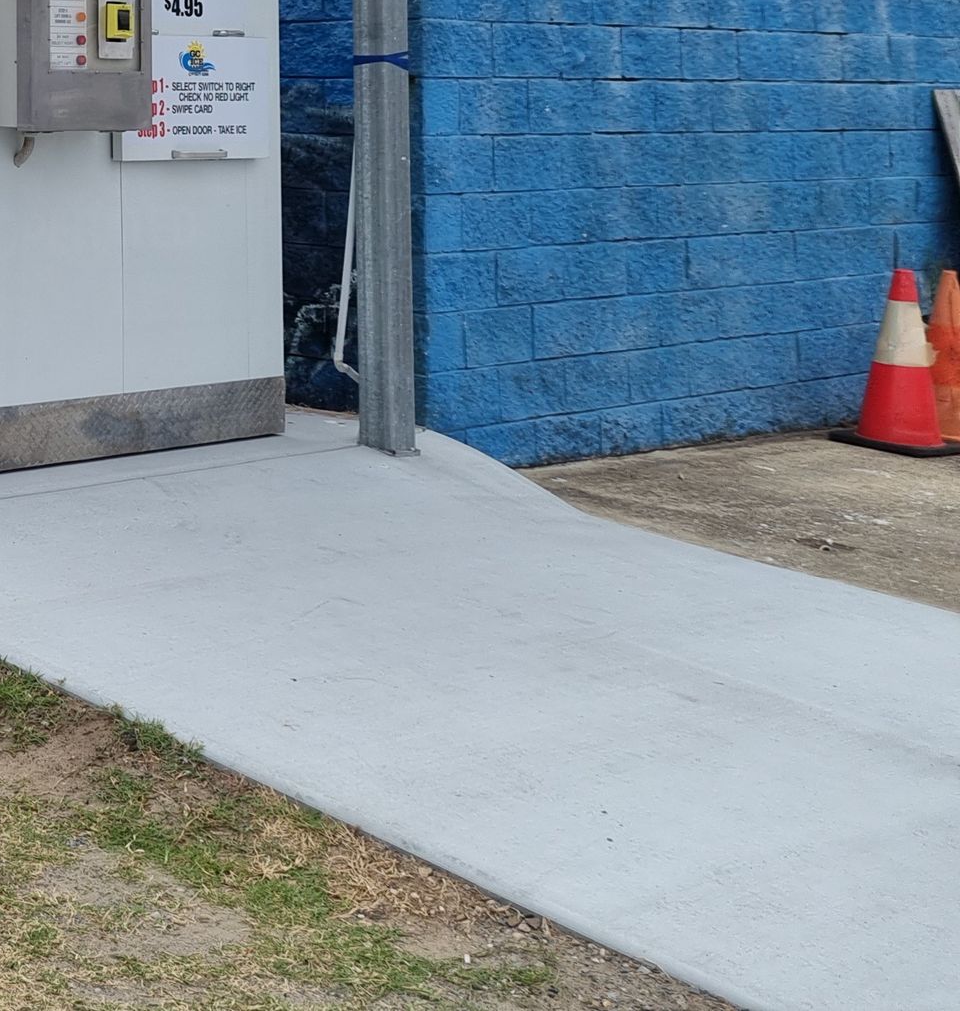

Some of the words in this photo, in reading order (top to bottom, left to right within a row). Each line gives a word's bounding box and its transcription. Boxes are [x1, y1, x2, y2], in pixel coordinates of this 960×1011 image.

[171, 82, 197, 92] SELECT
[198, 82, 224, 91] SWITCH
[225, 82, 234, 91] TO
[235, 82, 256, 92] RIGHT
[179, 92, 201, 102] CHECK
[203, 93, 214, 102] NO
[215, 93, 228, 102] RED
[172, 104, 193, 114] SWIPE
[194, 104, 213, 114] CARD
[172, 126, 192, 135] OPEN
[193, 126, 213, 135] DOOR
[218, 125, 234, 135] TAKE
[236, 125, 247, 135] ICE
